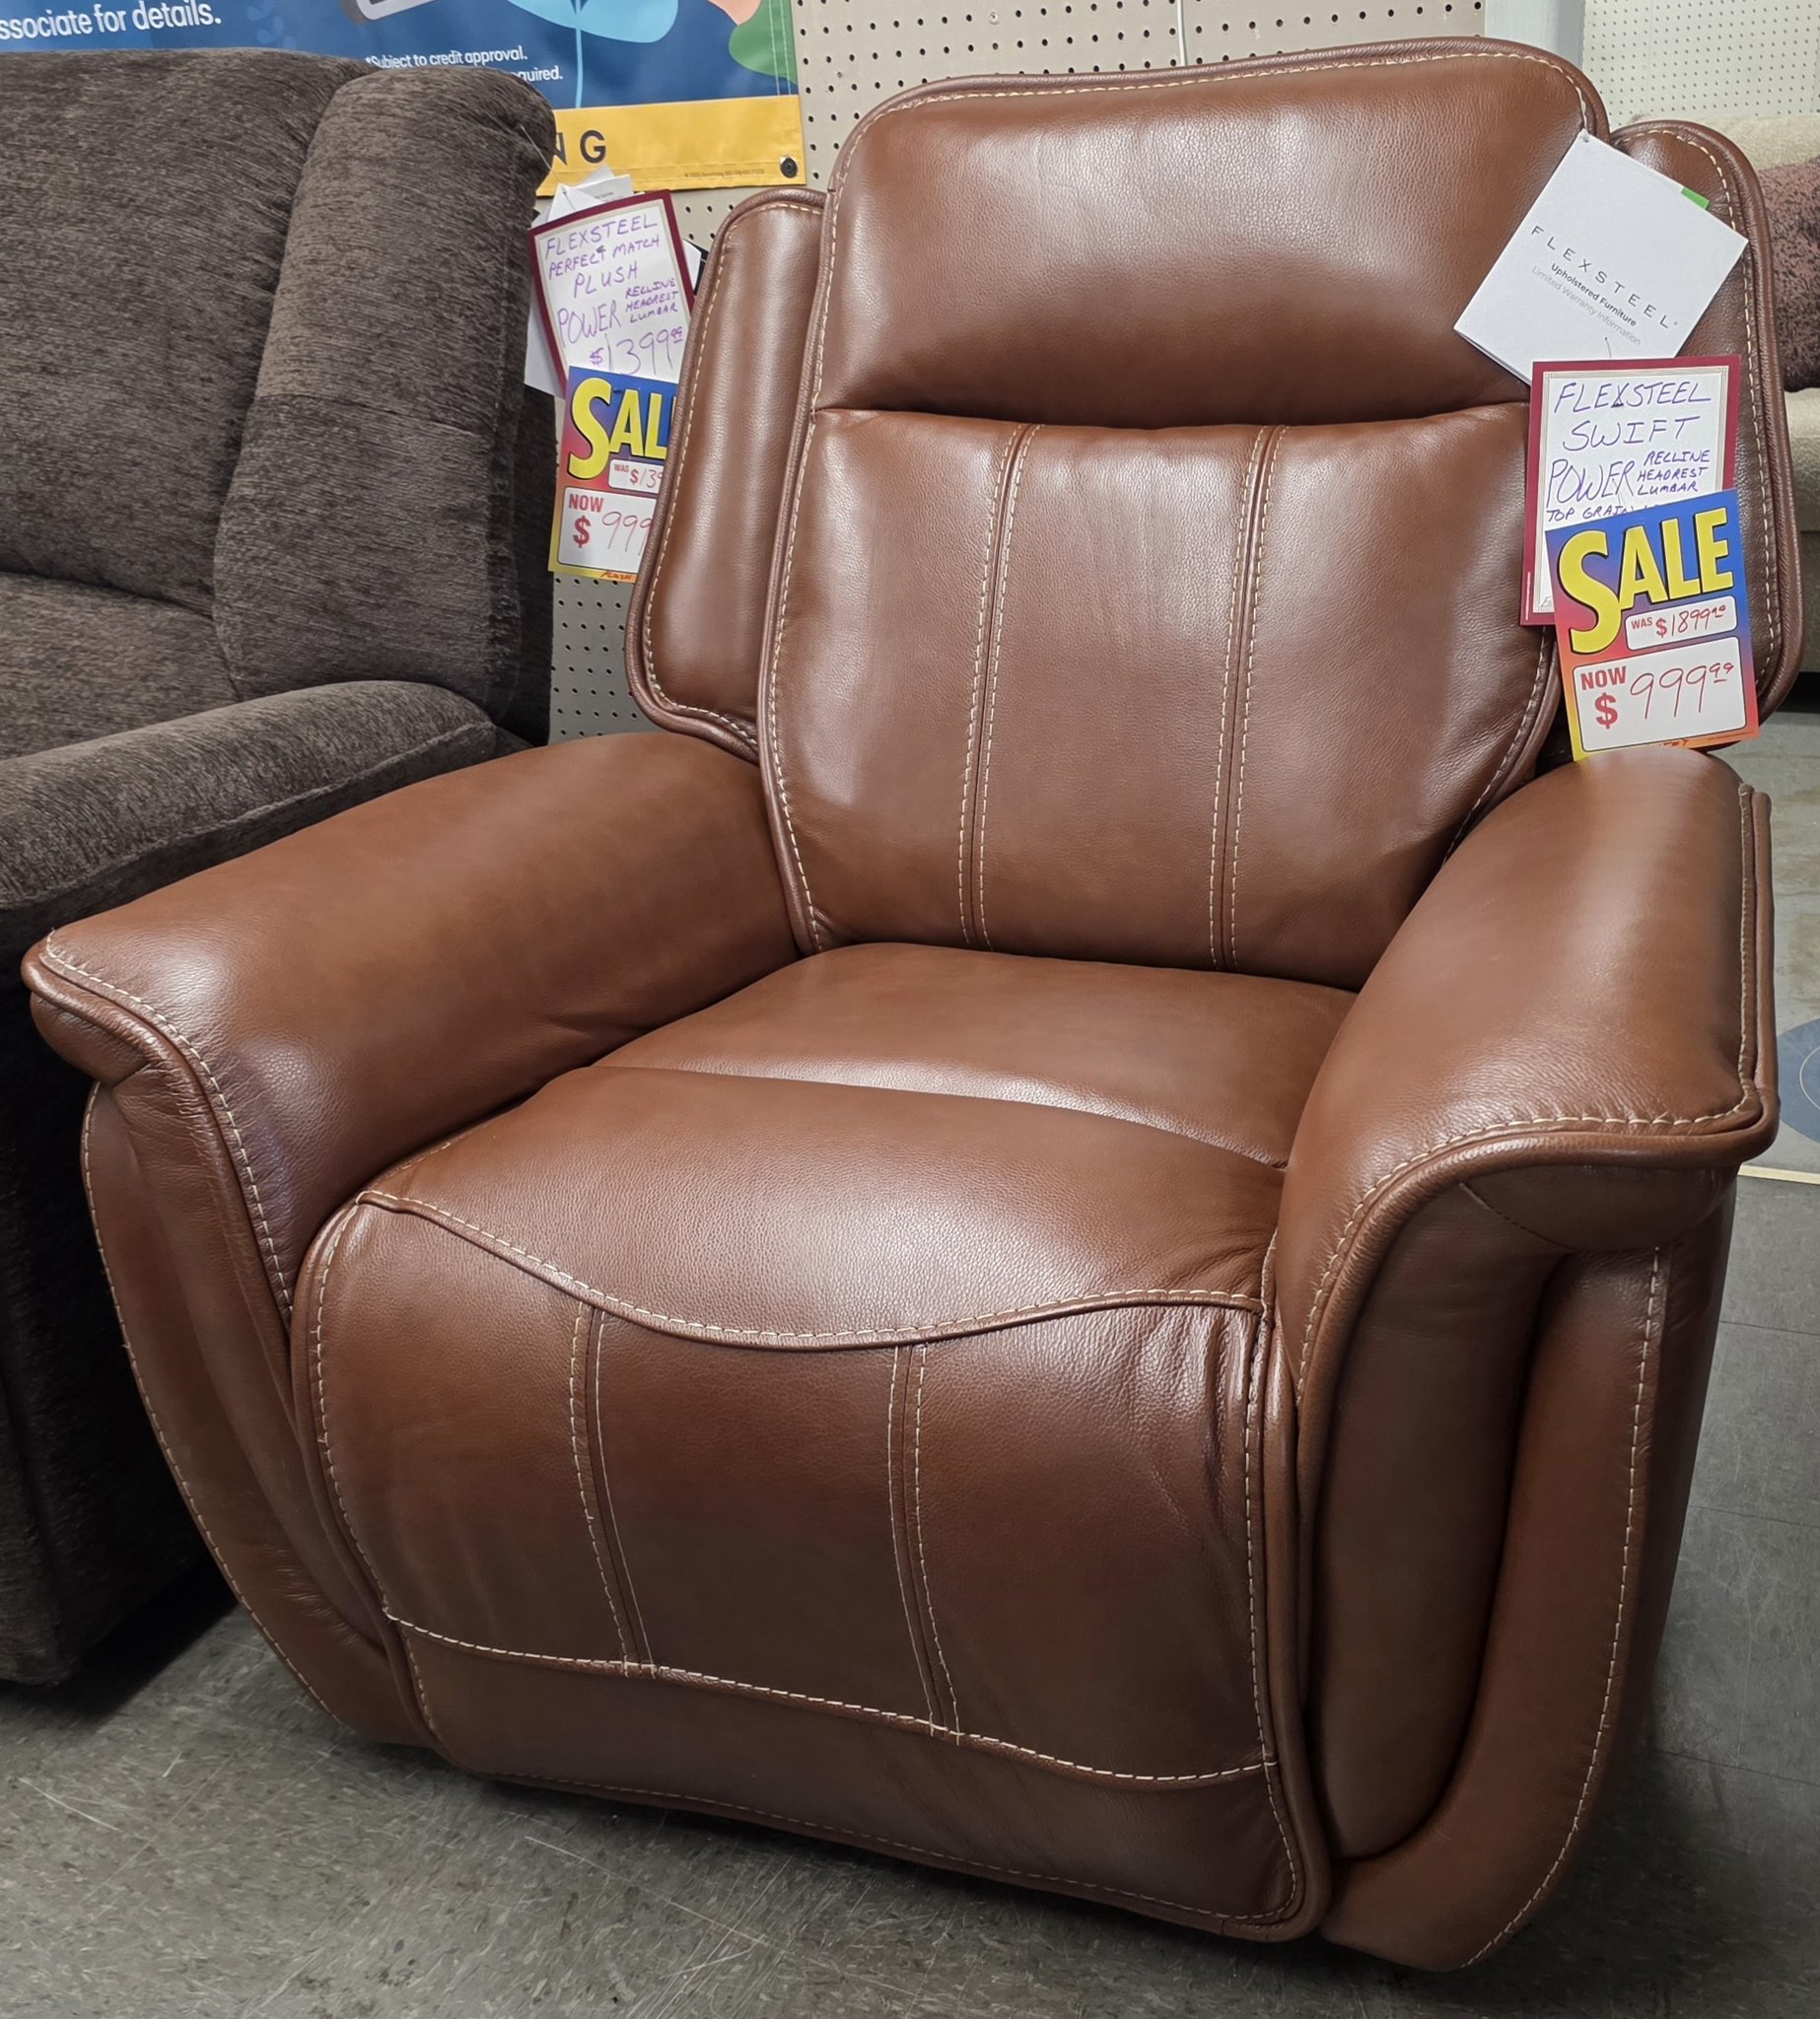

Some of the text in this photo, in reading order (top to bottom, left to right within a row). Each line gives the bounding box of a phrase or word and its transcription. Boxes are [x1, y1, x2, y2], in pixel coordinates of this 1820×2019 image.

[94, 4, 127, 33] for
[132, 0, 222, 31] details.
[413, 54, 427, 67] to
[429, 49, 463, 66] credit
[464, 45, 528, 66] approval.
[545, 214, 659, 260] FLEXSTEEL
[548, 234, 660, 280] PERFECT MATCH
[574, 260, 638, 299] PLUSH
[1530, 226, 1671, 329] FLEXSTEEL
[625, 292, 678, 313] HEADREST
[1531, 265, 1642, 346] Limited Warranty Information
[1551, 263, 1637, 327] Upholstered Furniture
[558, 300, 621, 348] POWER
[630, 303, 678, 323] LUMBAR
[1554, 382, 1712, 413] FLEXSTEEL
[567, 378, 677, 479] SAL
[1563, 416, 1701, 452] SWIFT
[1637, 466, 1709, 482] HEADREST
[1644, 450, 1710, 466] RECLINE
[1546, 458, 1635, 508] POWER
[1638, 481, 1698, 496] LUMBAR
[568, 494, 603, 514] NOW
[1546, 507, 1575, 522] TOP
[1558, 507, 1734, 655] SALE
[1631, 617, 1652, 630] WAS
[1580, 666, 1627, 690] NOW
